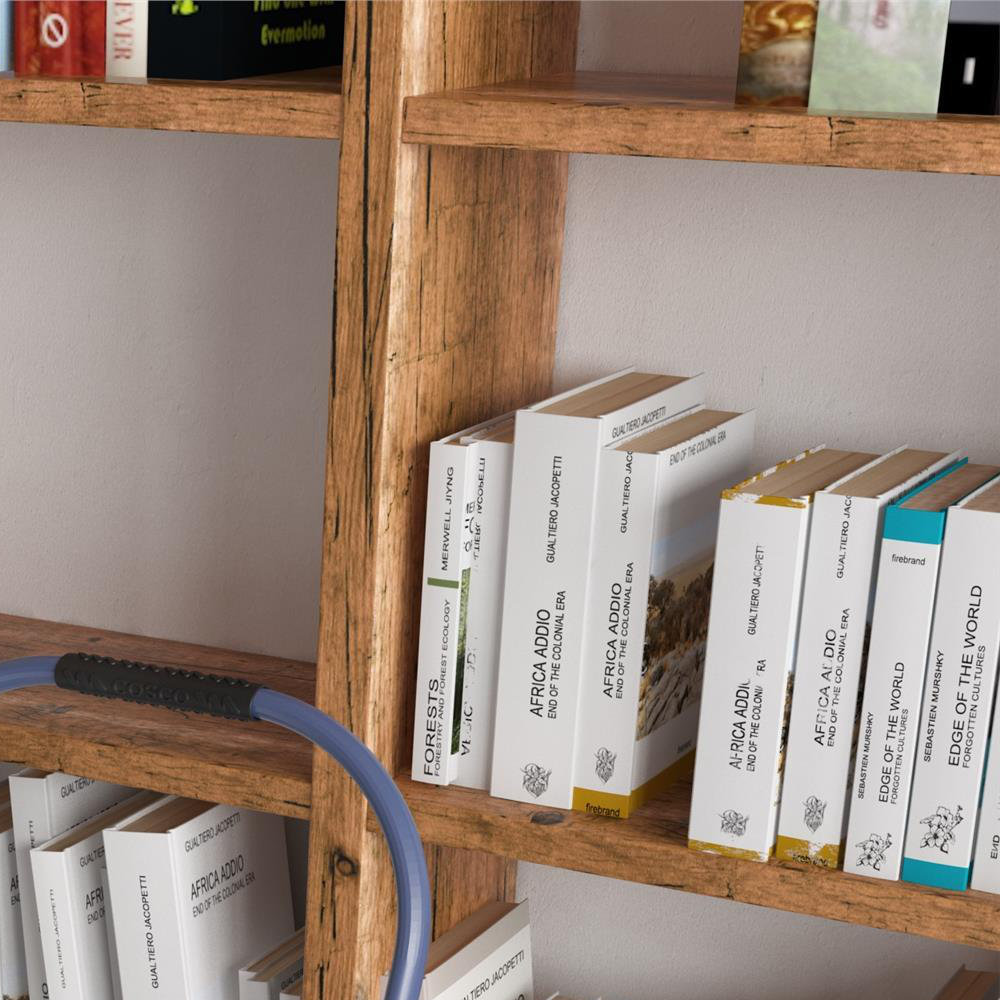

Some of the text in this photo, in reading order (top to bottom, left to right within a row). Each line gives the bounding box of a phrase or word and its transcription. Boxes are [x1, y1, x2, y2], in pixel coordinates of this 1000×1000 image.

[441, 466, 453, 570] MERWELL JIYNG
[546, 455, 562, 563] GUALTIERO JACOPETTI
[620, 476, 631, 533] GUALTIERO
[836, 520, 849, 578] GUALTIERO
[891, 553, 926, 566] firebrand
[441, 599, 450, 651] ECOLOGY
[530, 609, 550, 717] AFRICA ADDIO
[547, 590, 566, 719] END OF THE COLONIAL ERA
[603, 582, 622, 697] AFRICA ADDIO
[615, 562, 634, 699] END OF THE COLONIAL ERA
[439, 653, 447, 695] FOREST
[923, 650, 944, 761] SEBASTIEN MURSHKY
[948, 585, 982, 766] EDGE OF THE WORLD
[962, 645, 986, 768] FORGOTTEN CULTURES
[423, 679, 438, 775] FORESTS
[434, 721, 443, 776] FORESTRY
[746, 753, 756, 772] END
[748, 740, 757, 753] OF
[750, 722, 760, 738] THE
[857, 711, 873, 799] SEBASTIEN MURSHKY
[878, 662, 904, 802] EDGE OF THE WORLD
[890, 708, 908, 804] FORGOTTEN CULTURES
[191, 854, 244, 900] AFRICA ADDIO
[139, 875, 159, 988] GUALTIERO JACOPETTI
[492, 950, 524, 985] JACOPETTI
